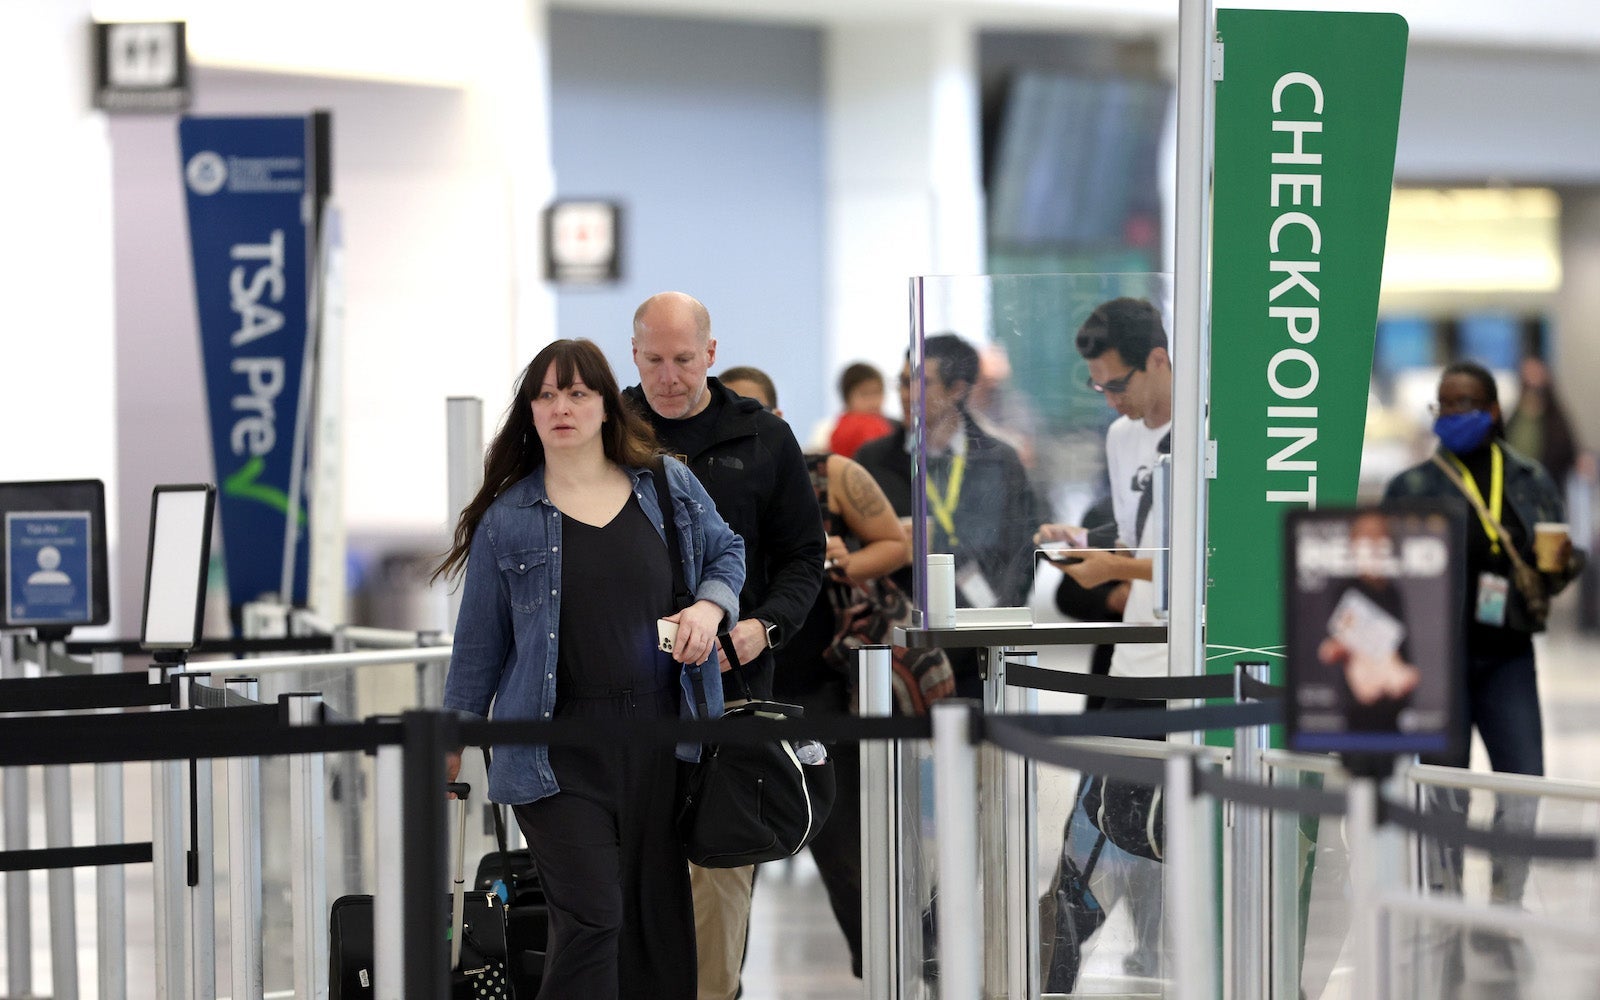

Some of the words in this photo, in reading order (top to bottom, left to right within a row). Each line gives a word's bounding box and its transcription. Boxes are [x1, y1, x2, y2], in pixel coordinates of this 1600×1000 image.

[230, 229, 286, 347] TSA
[1266, 71, 1325, 508] CHECKPOINT
[231, 357, 286, 456] Pre
